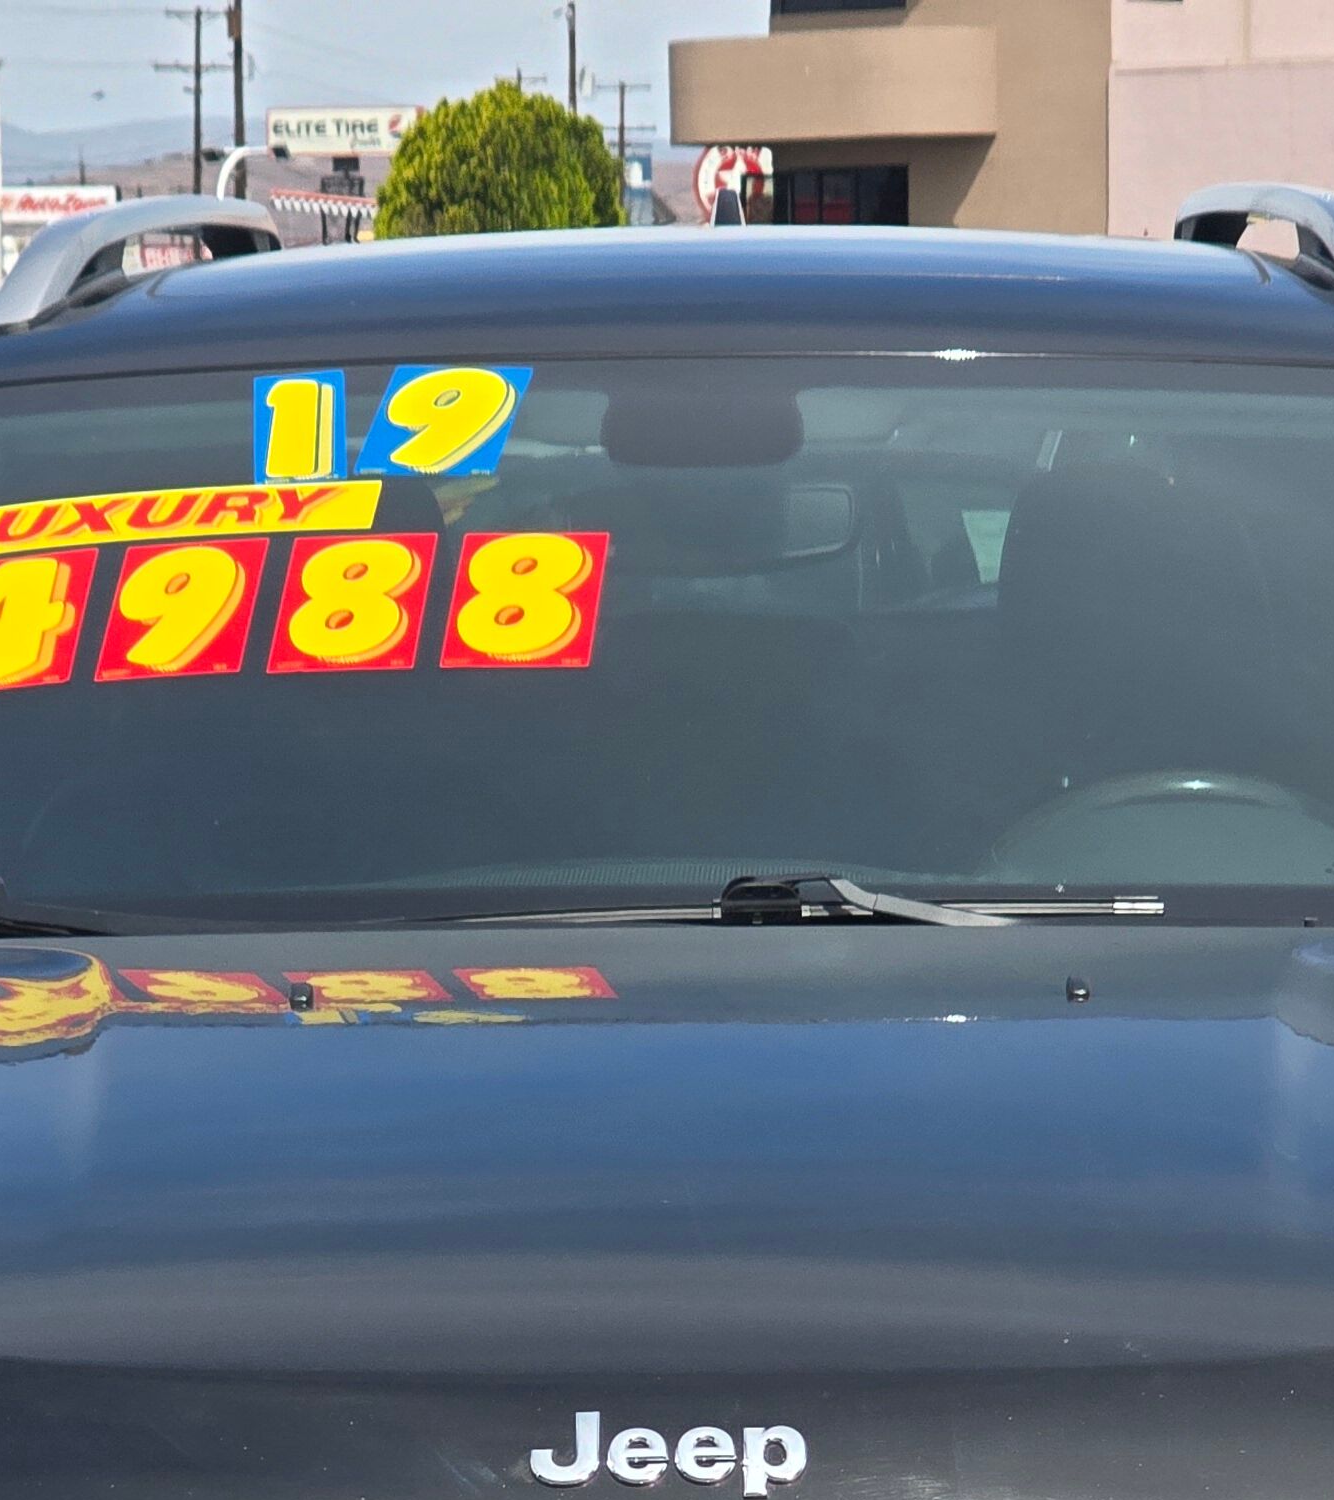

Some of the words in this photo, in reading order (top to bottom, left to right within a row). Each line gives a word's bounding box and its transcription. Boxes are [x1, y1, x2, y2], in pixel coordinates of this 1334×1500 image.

[272, 118, 327, 136] ELITE
[333, 117, 379, 137] TIRE
[530, 1411, 807, 1499] Jeep
